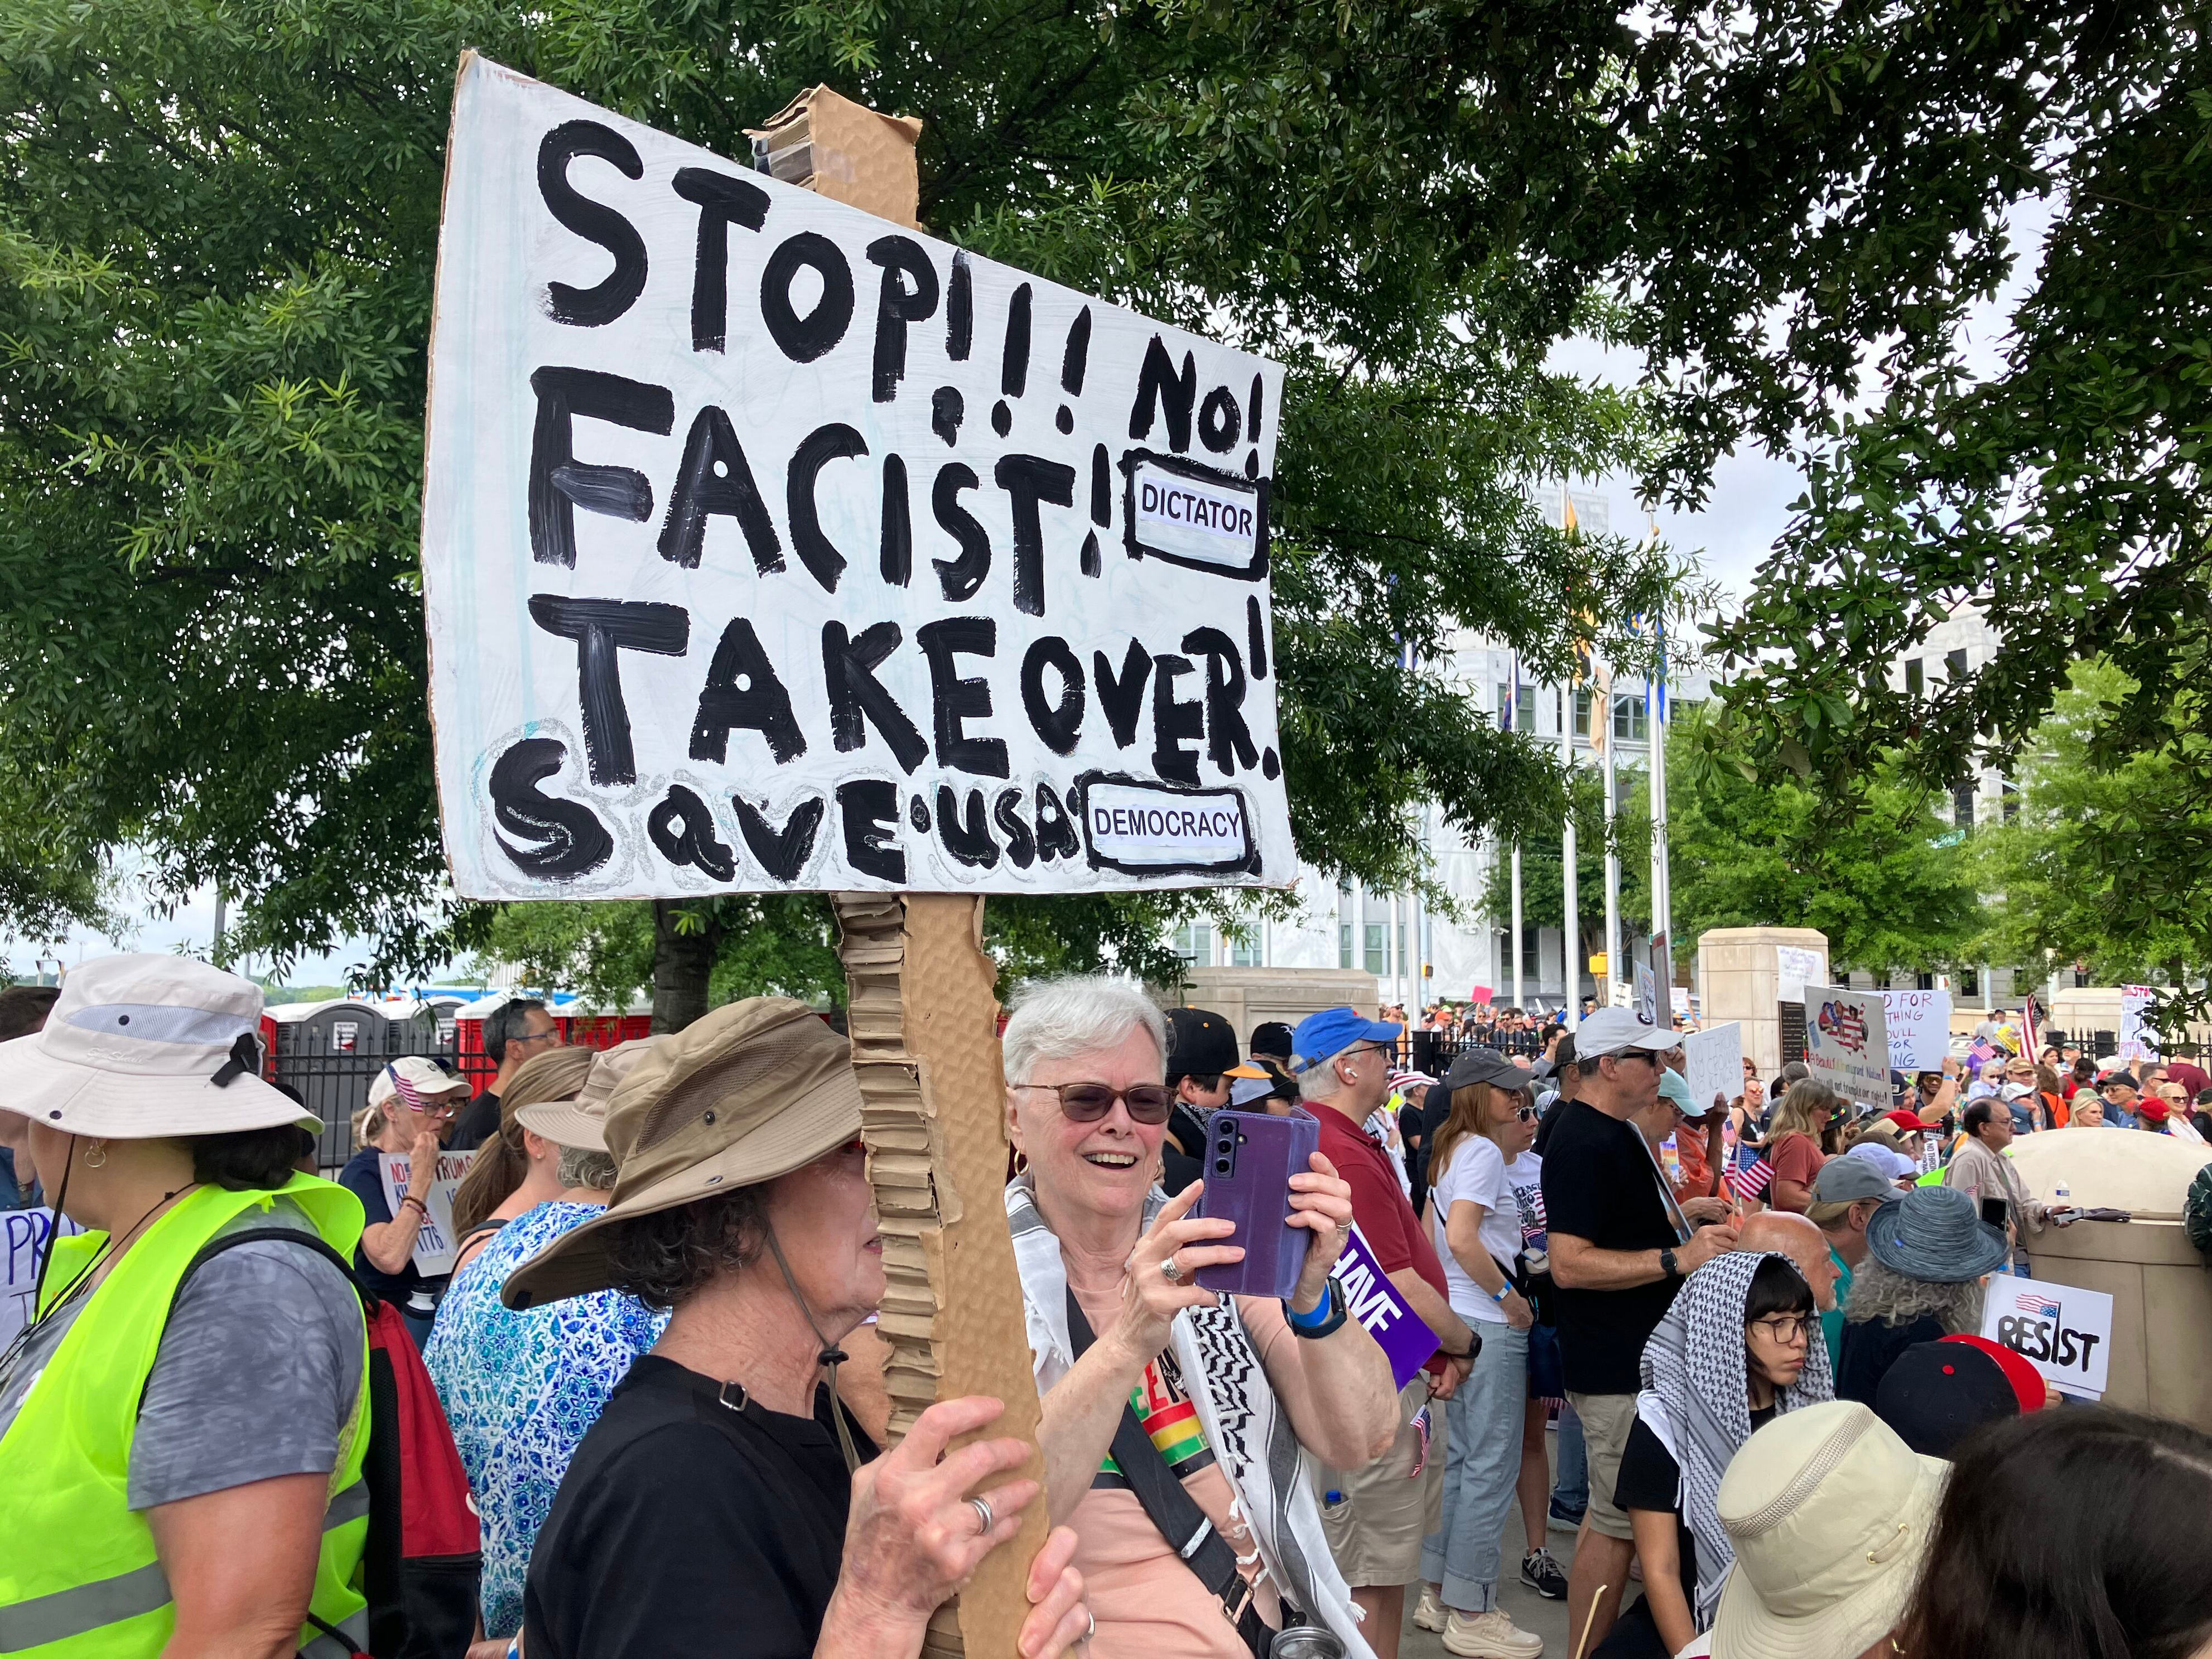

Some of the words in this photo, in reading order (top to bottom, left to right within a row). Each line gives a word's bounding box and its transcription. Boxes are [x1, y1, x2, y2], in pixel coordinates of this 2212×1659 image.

[537, 119, 1092, 448] STOP!!!
[528, 366, 1111, 617] FACIST!
[1142, 483, 1252, 537] DICTATOR
[1094, 808, 1240, 837] DEMOCRACY
[1900, 993, 1933, 1009] FOR
[1885, 1009, 1923, 1025] THING
[1887, 1028, 1916, 1039] OU'LL
[1890, 1052, 1915, 1067] ING
[1928, 1152, 1937, 1172] THRON
[391, 1163, 406, 1183] NO
[394, 1184, 408, 1207] KI
[1998, 1302, 2100, 1372] RESIST
